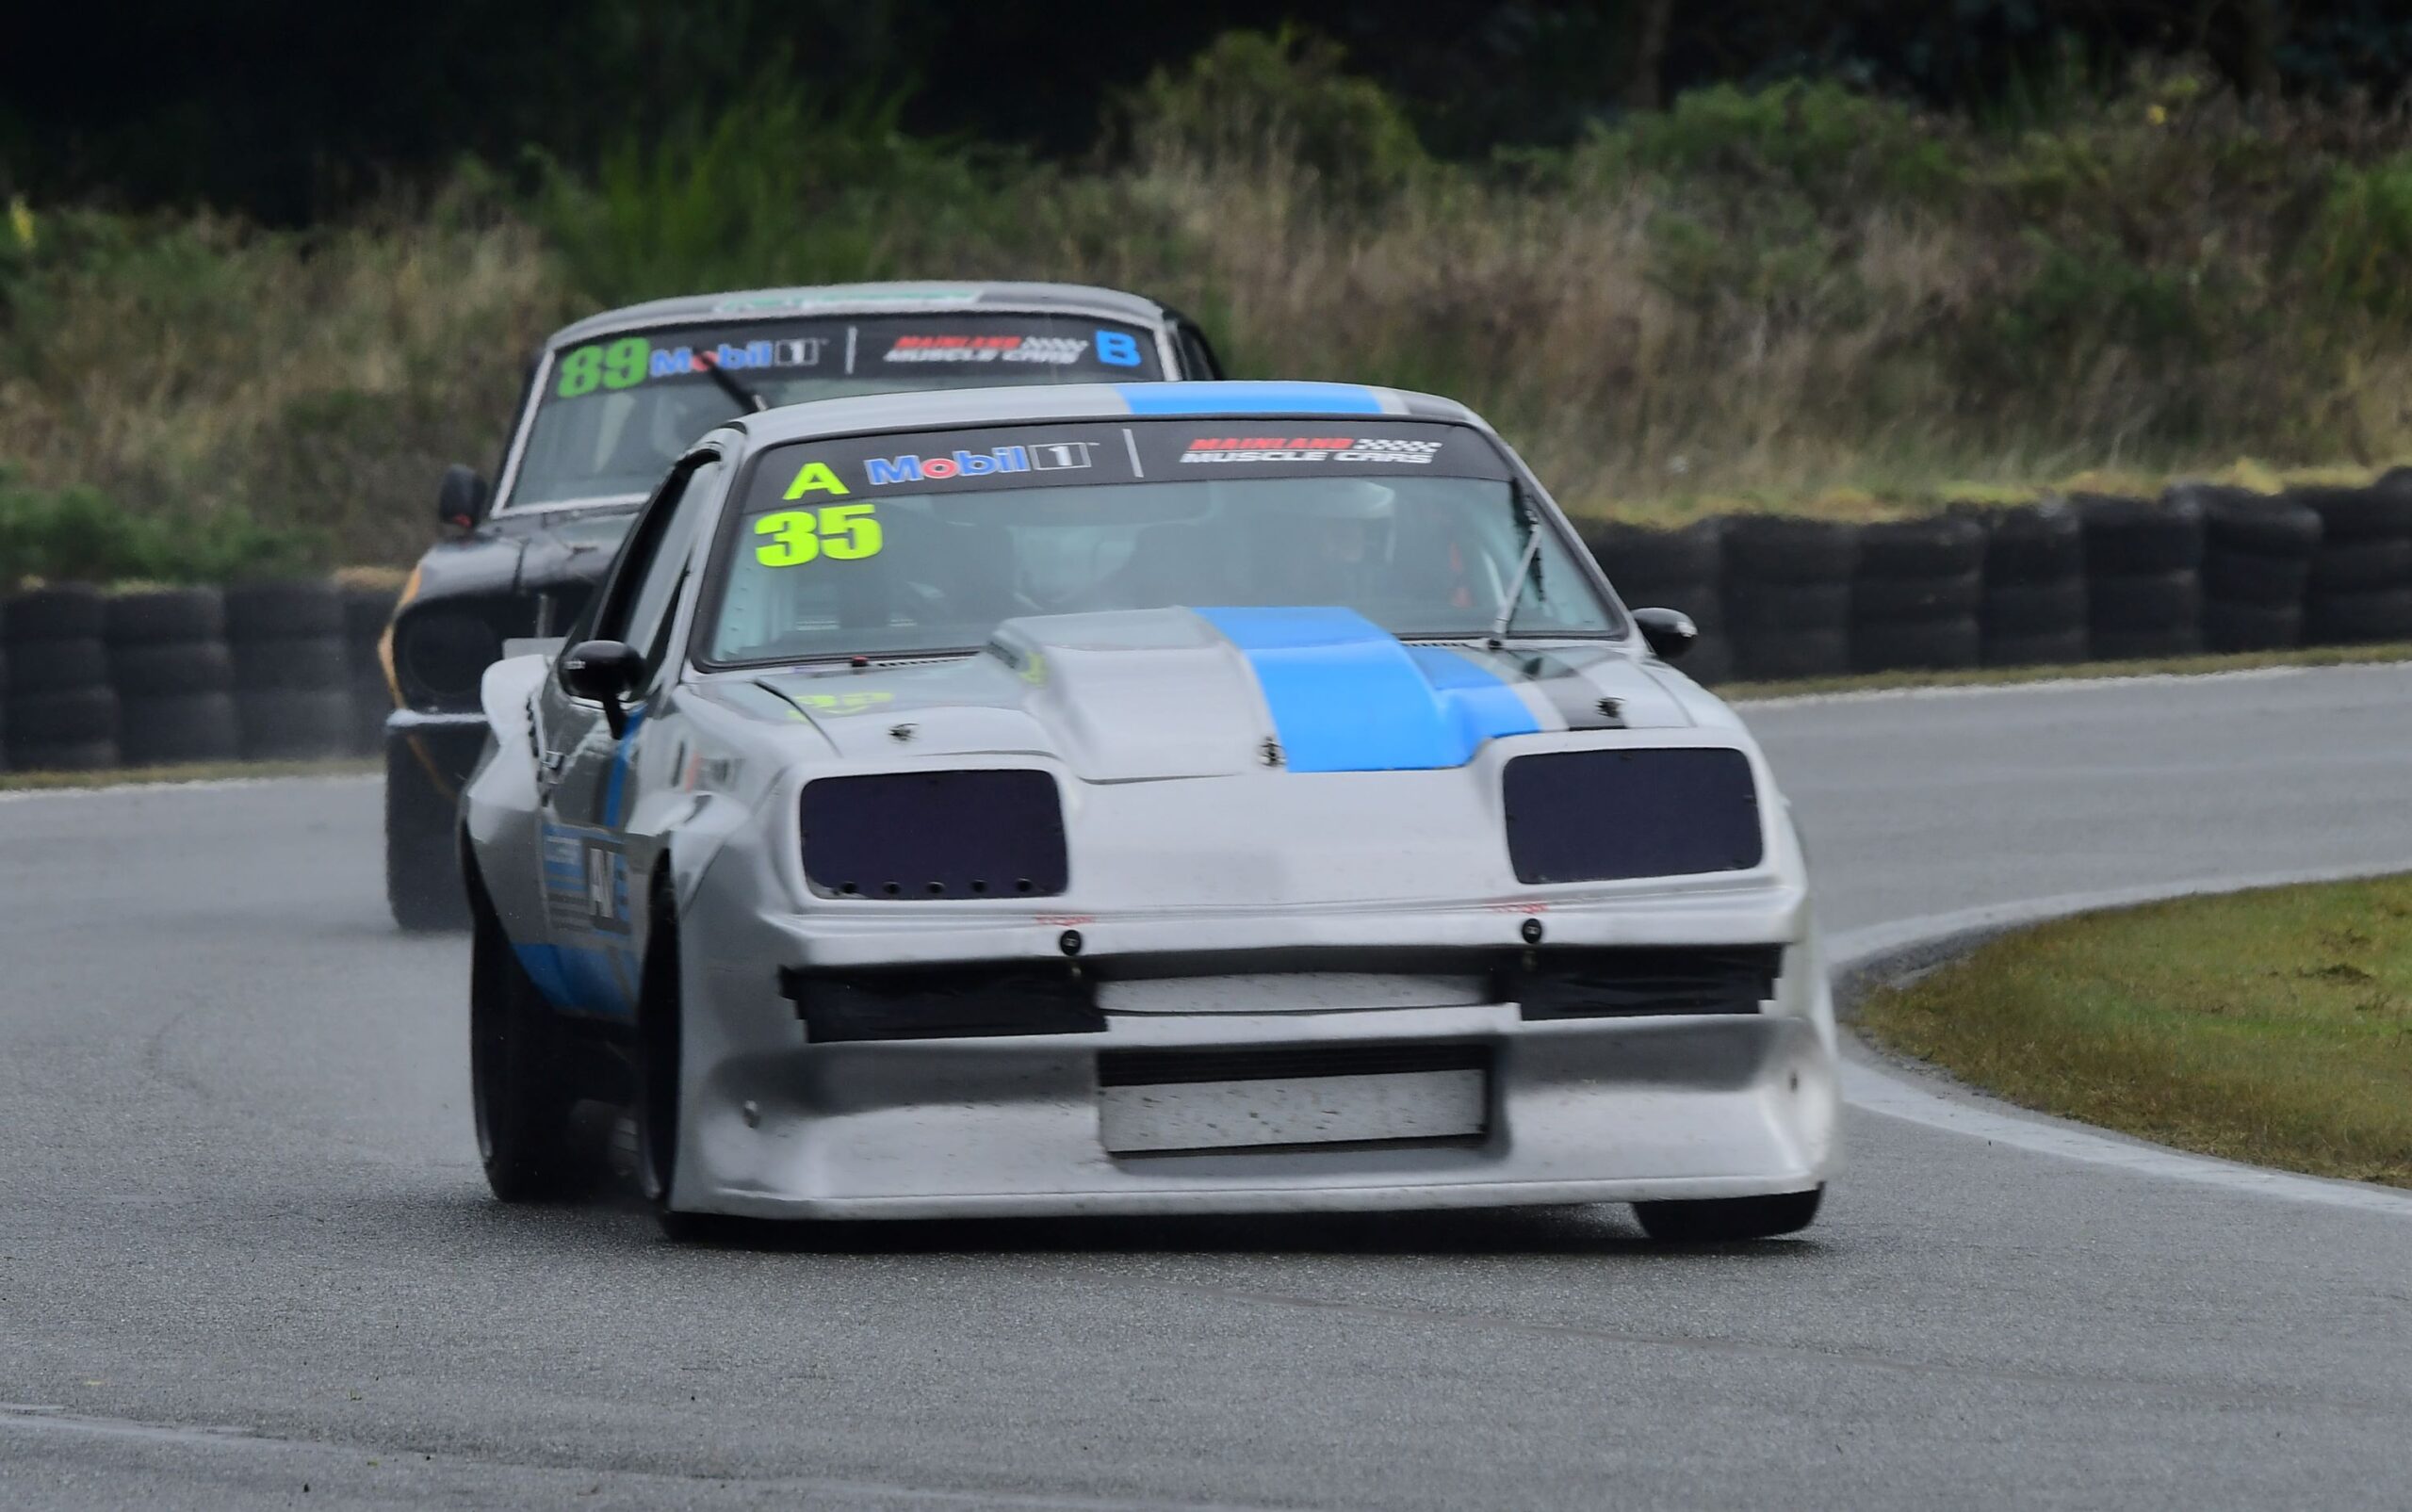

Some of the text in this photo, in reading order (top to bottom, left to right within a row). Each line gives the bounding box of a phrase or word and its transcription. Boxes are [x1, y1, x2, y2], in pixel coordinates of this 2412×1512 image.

[558, 337, 650, 398] 89
[649, 340, 772, 377] Mobil
[1094, 329, 1142, 368] B
[1180, 451, 1434, 463] MUSCLE CARS
[1189, 438, 1355, 450] MAINLAND
[783, 462, 849, 500] A
[864, 446, 1031, 485] Mobil
[755, 504, 882, 568] 35
